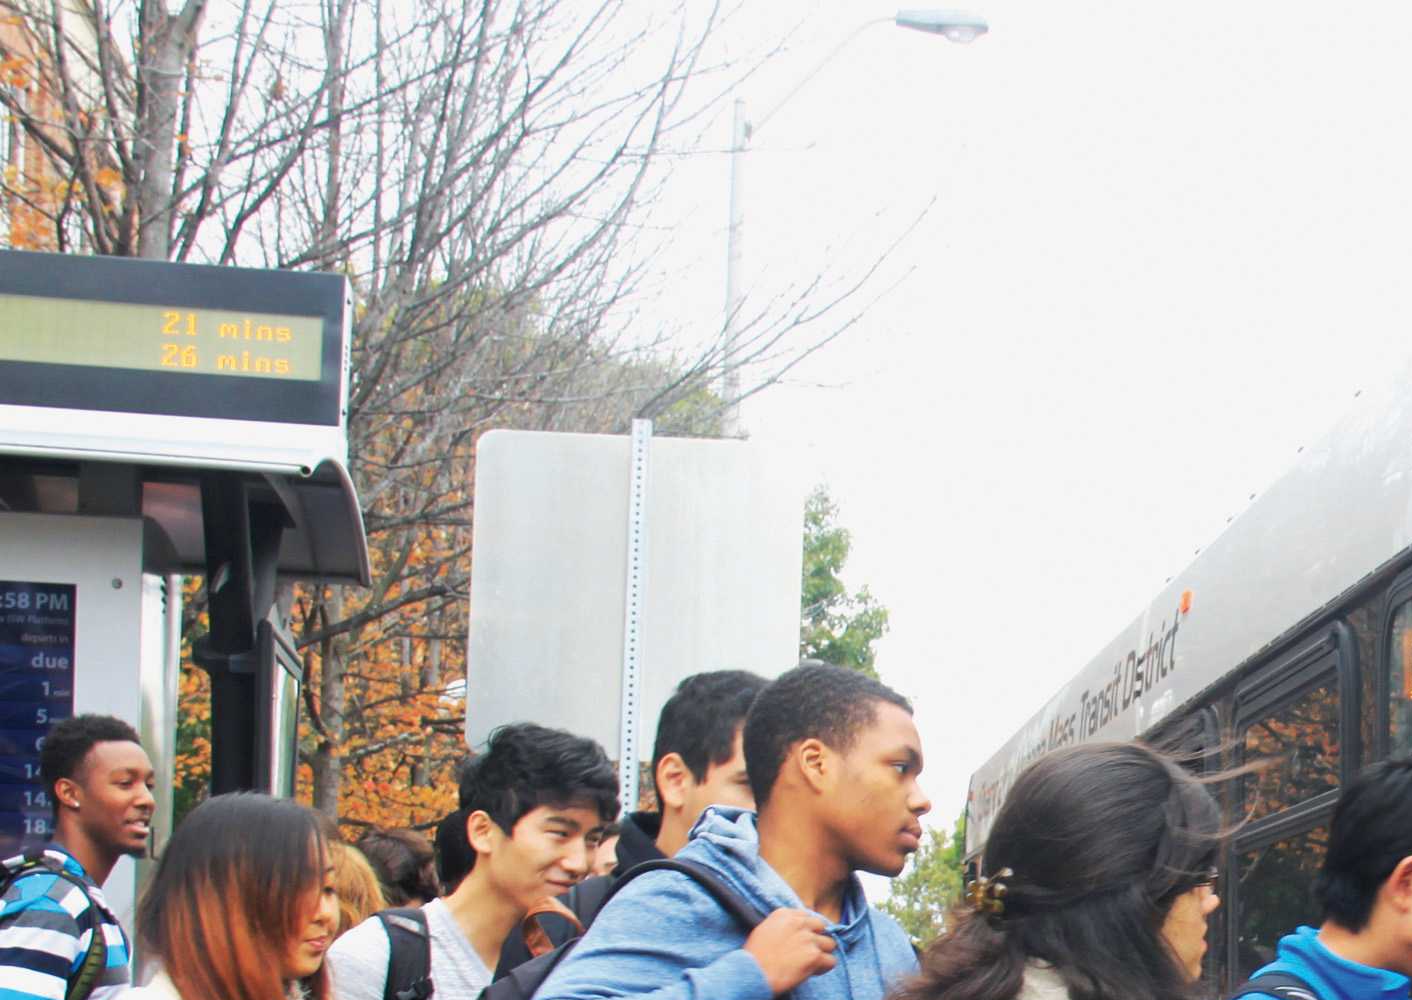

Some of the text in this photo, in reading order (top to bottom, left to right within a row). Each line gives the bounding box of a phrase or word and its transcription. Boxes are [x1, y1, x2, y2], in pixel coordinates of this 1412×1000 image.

[160, 310, 293, 343] 21 mins
[160, 343, 291, 375] 26 mins
[35, 592, 69, 611] PM
[31, 652, 69, 669] due
[41, 681, 51, 696] 1
[1080, 660, 1122, 742] Transit
[36, 709, 47, 724] 5
[24, 791, 46, 807] 14
[24, 819, 46, 834] 18
